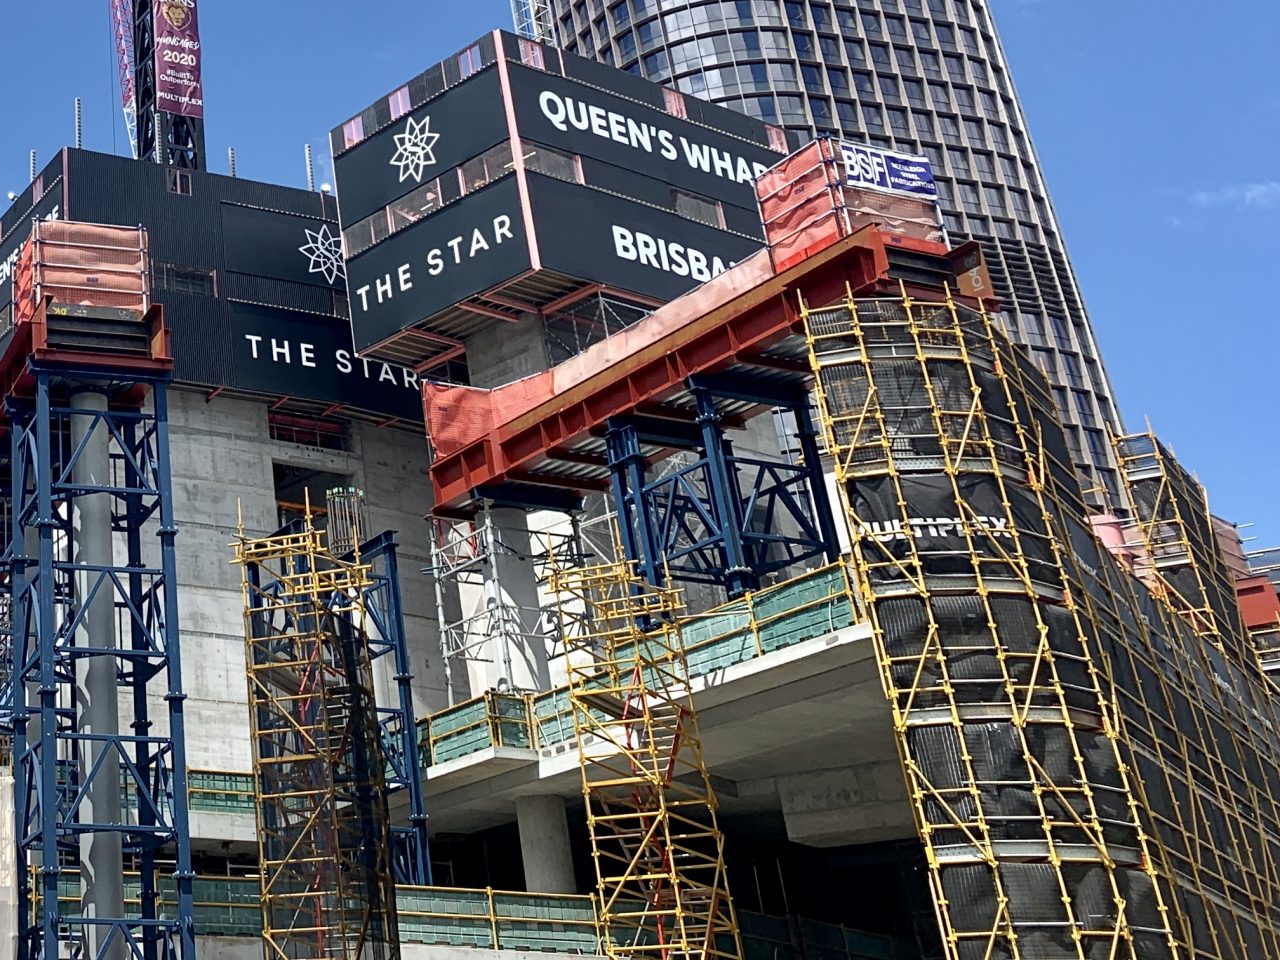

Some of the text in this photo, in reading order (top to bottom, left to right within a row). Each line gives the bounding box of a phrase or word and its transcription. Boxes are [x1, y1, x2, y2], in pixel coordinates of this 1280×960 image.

[163, 49, 196, 66] 2020
[157, 91, 203, 106] MULTIPLEX
[539, 90, 677, 161] QUEEN'S
[842, 150, 885, 182] BSF
[356, 214, 514, 312] THE STAR
[245, 334, 420, 391] THE STAR
